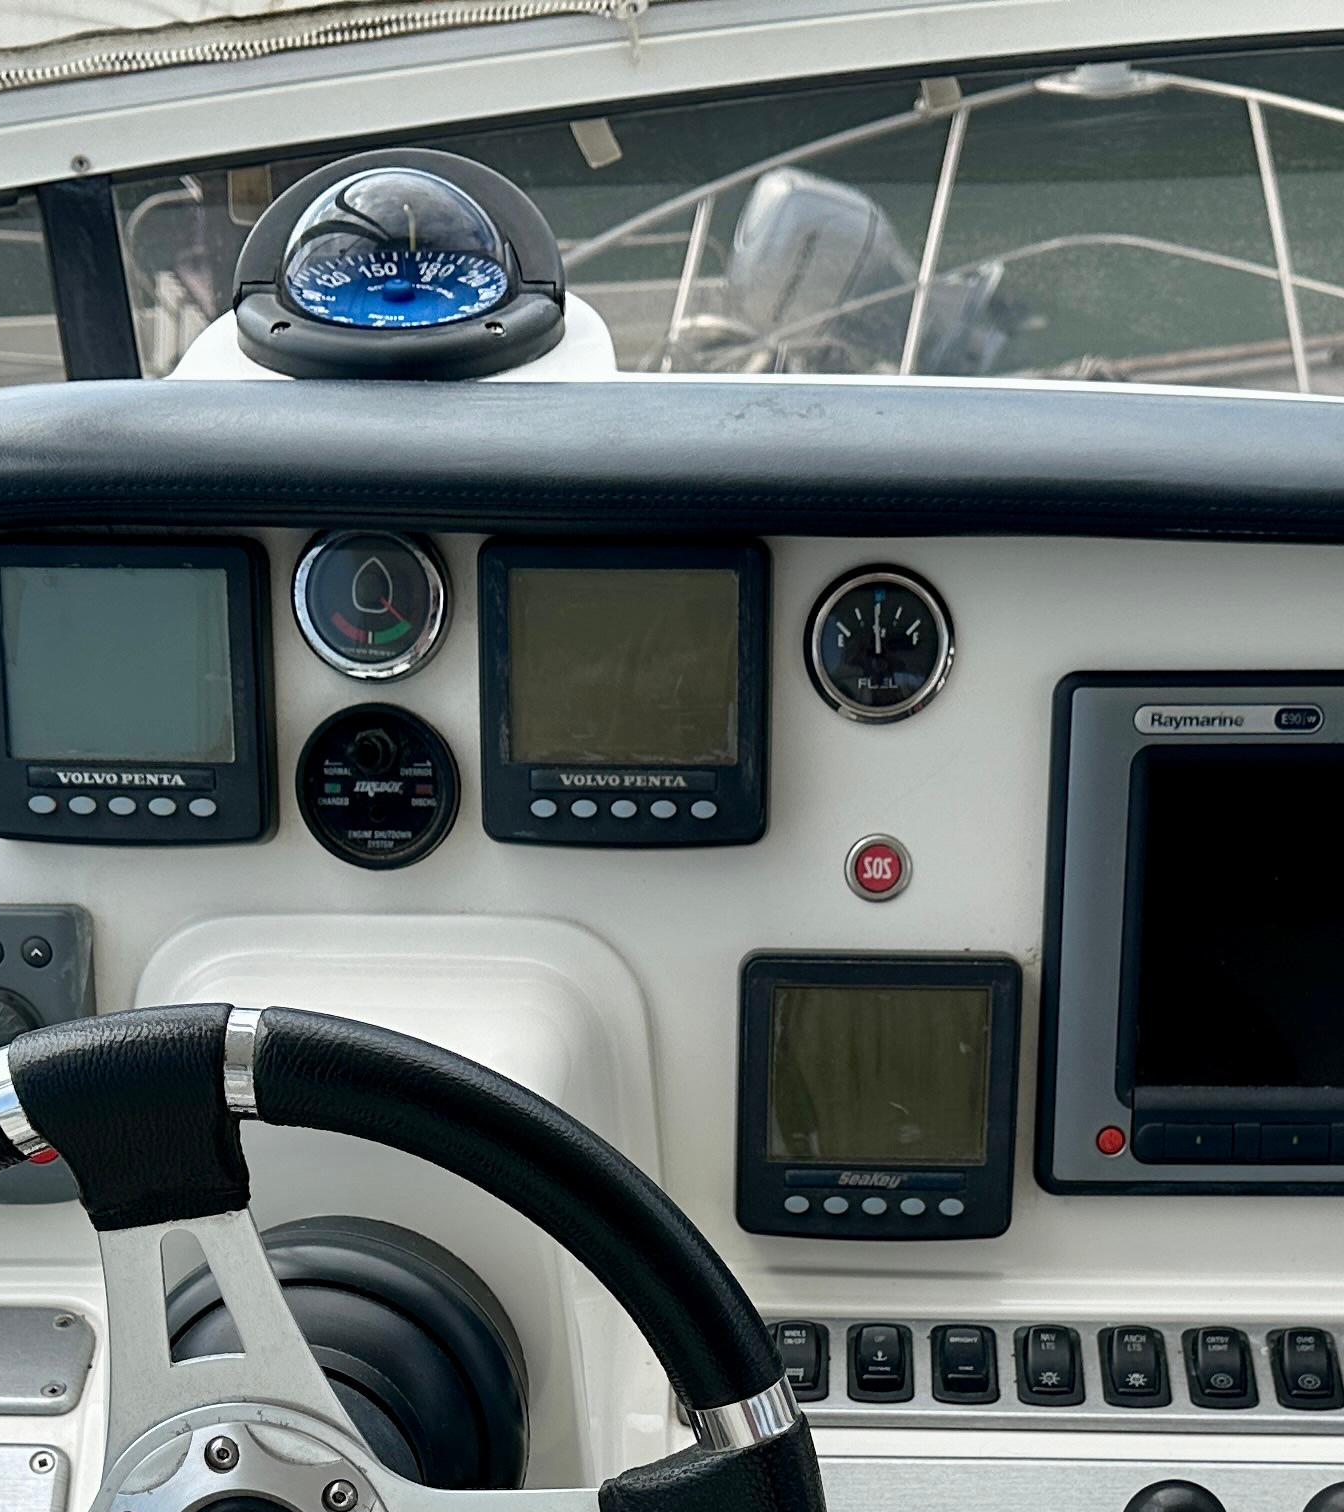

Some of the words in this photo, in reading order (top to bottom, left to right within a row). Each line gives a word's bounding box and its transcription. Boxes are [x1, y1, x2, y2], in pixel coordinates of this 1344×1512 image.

[359, 262, 397, 279] 150
[1151, 711, 1244, 731] Raymarine
[56, 772, 118, 785] VOLVO
[121, 773, 186, 786] PENTA
[559, 774, 620, 786] VOLVO
[623, 775, 688, 788] PENTA
[1123, 1334, 1147, 1344] ANCH
